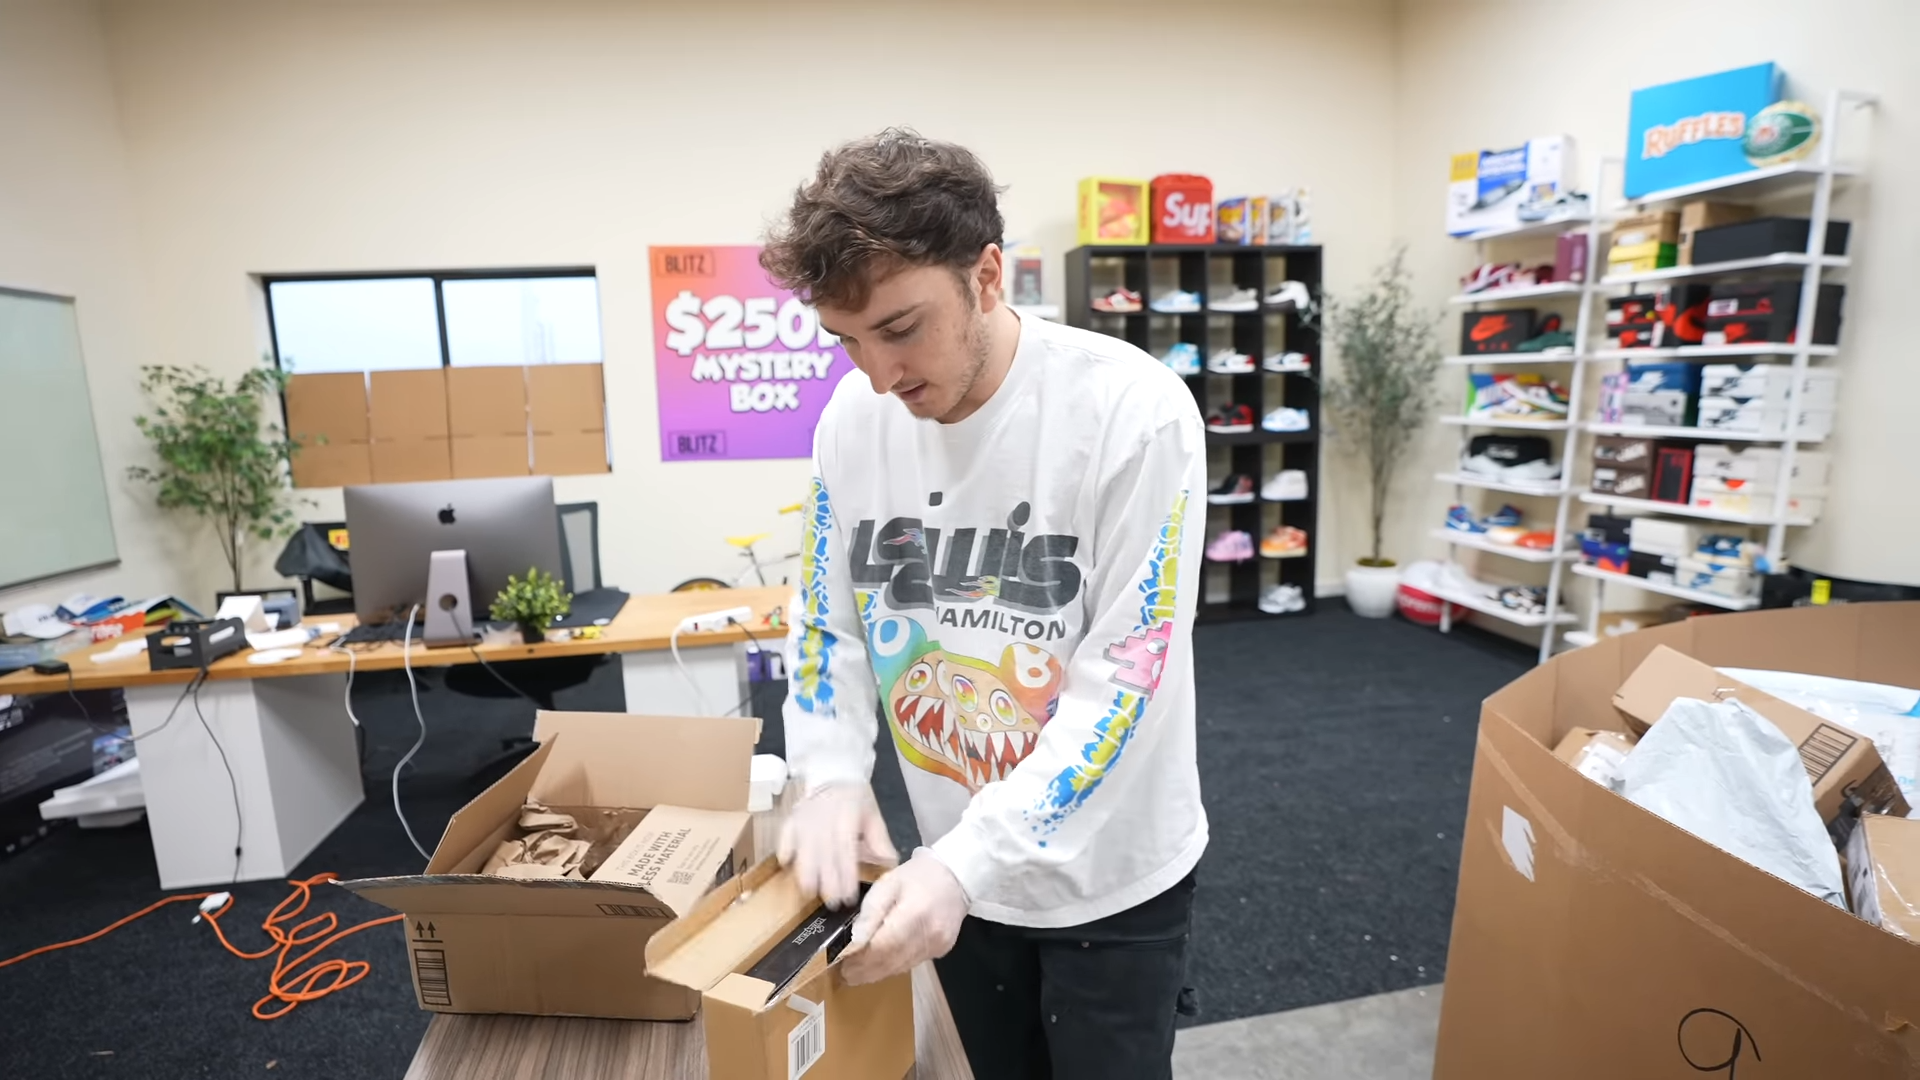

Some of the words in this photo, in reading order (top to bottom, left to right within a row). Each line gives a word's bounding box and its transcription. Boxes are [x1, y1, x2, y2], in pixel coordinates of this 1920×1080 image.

[1641, 111, 1746, 160] RUFFLES
[665, 254, 706, 274] BLITZ
[691, 352, 835, 383] MYSTERY
[729, 382, 800, 413] BOX
[677, 434, 718, 454] BLITZ
[627, 851, 655, 877] MADE
[647, 830, 673, 854] WITH
[640, 865, 661, 887] LESS
[656, 828, 691, 866] MATERIAL
